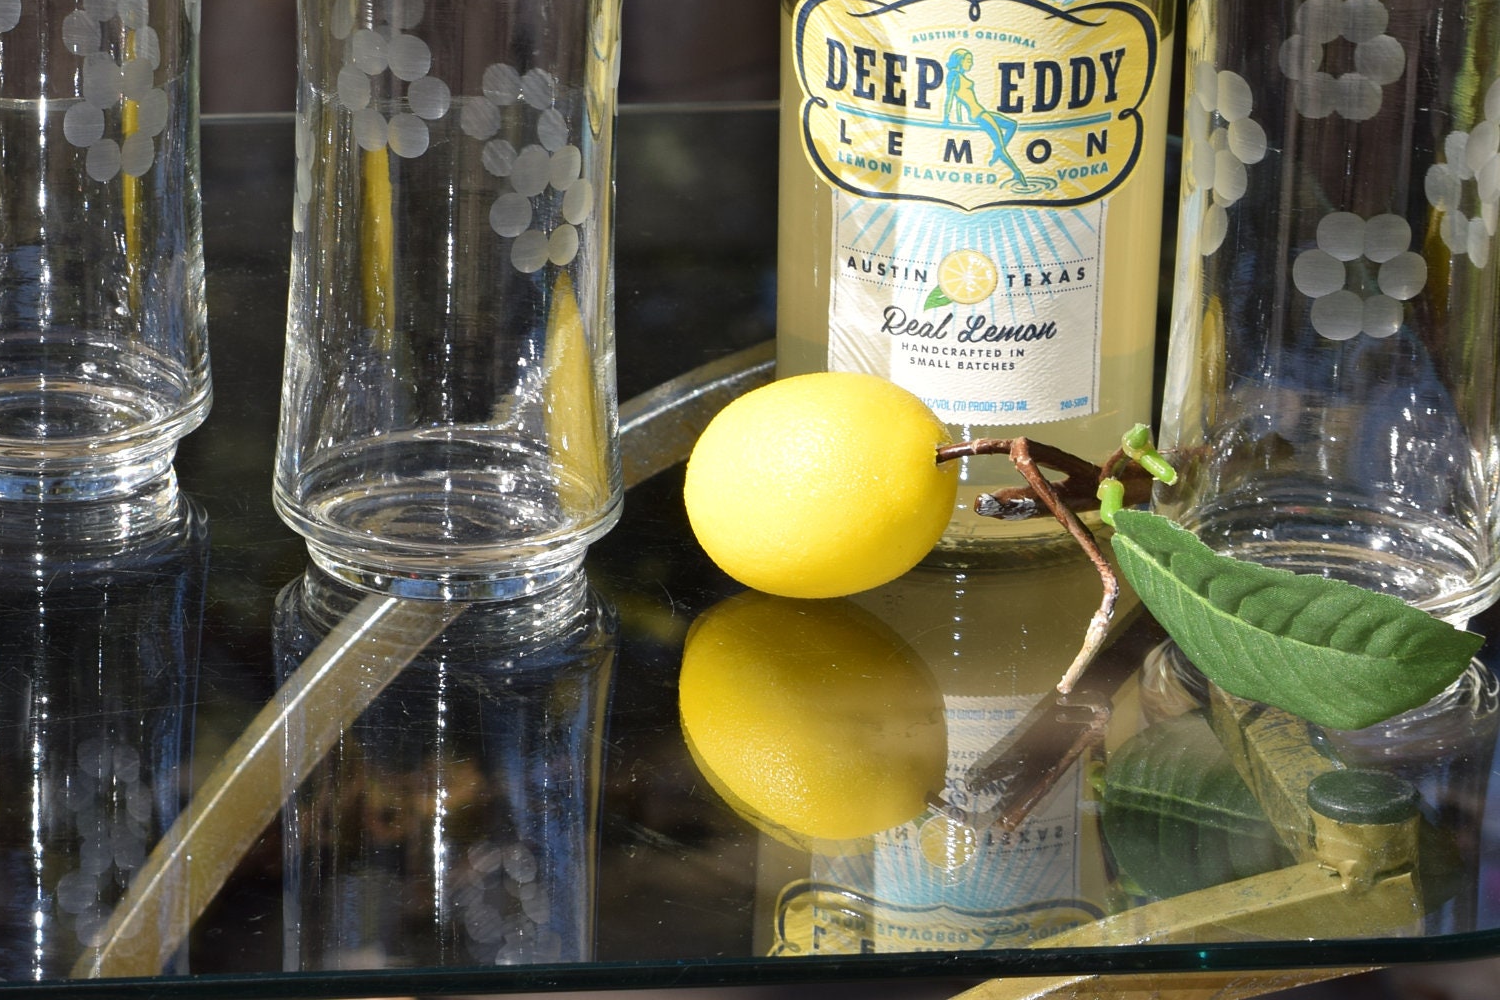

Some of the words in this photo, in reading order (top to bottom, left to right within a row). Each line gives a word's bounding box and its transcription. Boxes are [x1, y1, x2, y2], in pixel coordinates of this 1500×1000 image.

[912, 30, 969, 44] AUSTIN'S
[975, 30, 1036, 48] ORIGINAL
[825, 37, 944, 110] DEEP
[996, 47, 1127, 114] EDDY
[839, 118, 1108, 164] LEMON
[838, 151, 892, 175] LEMON
[903, 166, 998, 186] FLAVORED
[1056, 161, 1110, 181] VODKA
[847, 255, 928, 283] AUSTIN
[1007, 267, 1087, 288] TEXAS
[880, 305, 954, 340] Real
[957, 314, 1058, 344] Lemon
[901, 342, 1001, 358] HANDCRAFTED
[1010, 348, 1025, 358] IN
[909, 356, 951, 369] SMALL
[957, 361, 1016, 371] BATCHES
